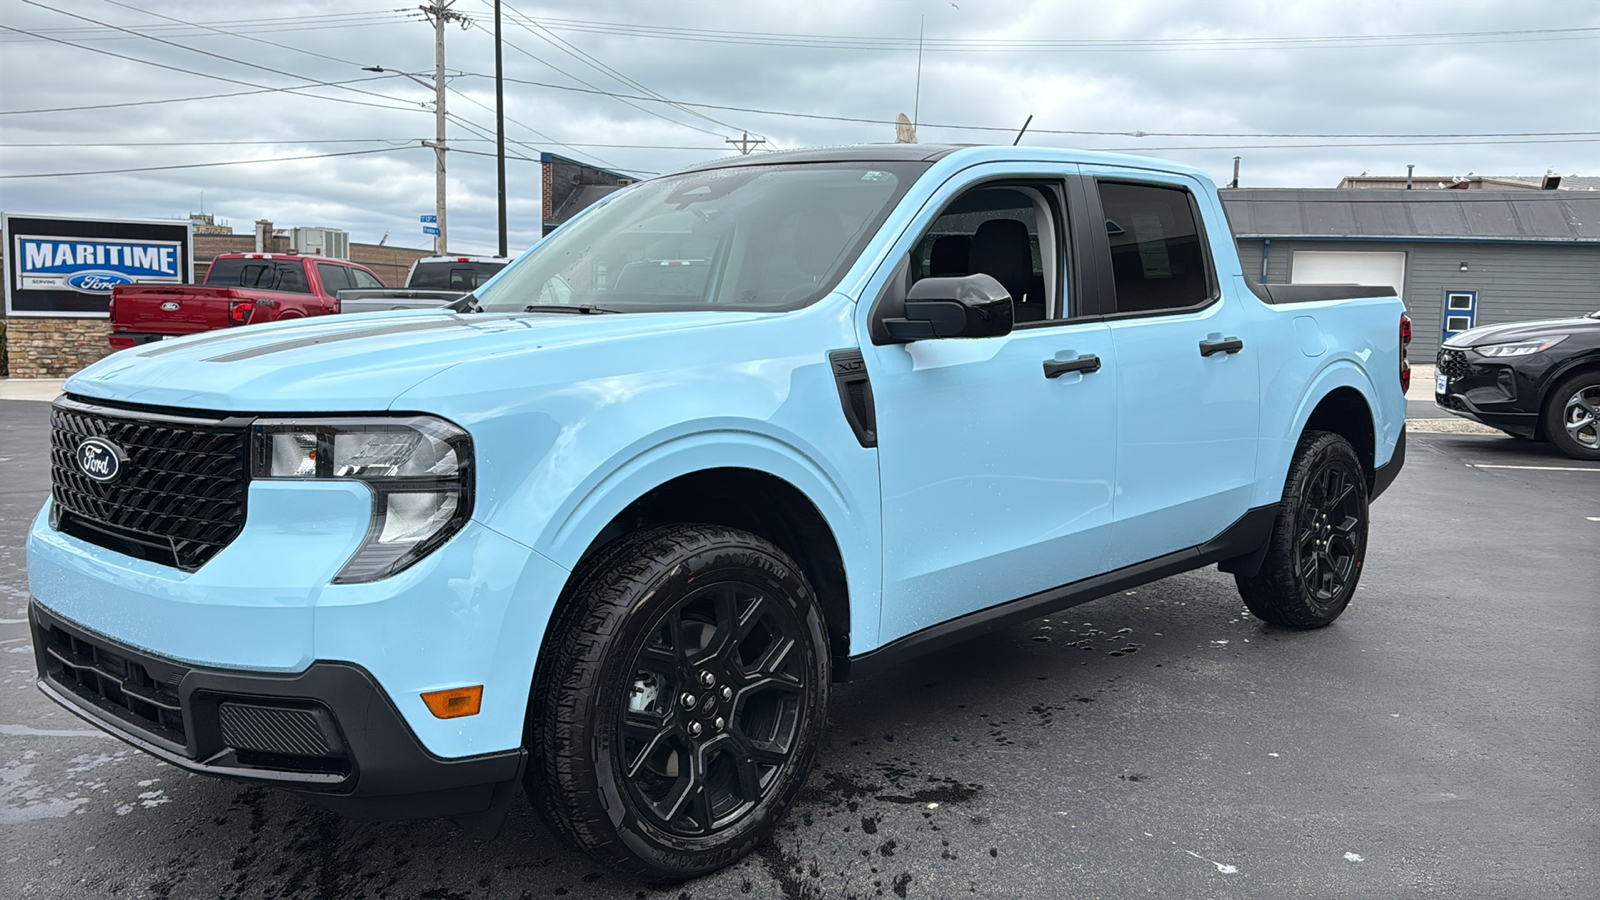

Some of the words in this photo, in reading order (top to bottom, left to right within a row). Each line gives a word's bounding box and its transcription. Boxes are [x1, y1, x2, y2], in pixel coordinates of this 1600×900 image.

[25, 242, 175, 274] MARITIME
[80, 275, 121, 289] Ford
[837, 361, 864, 372] XLT
[83, 444, 109, 475] Ford
